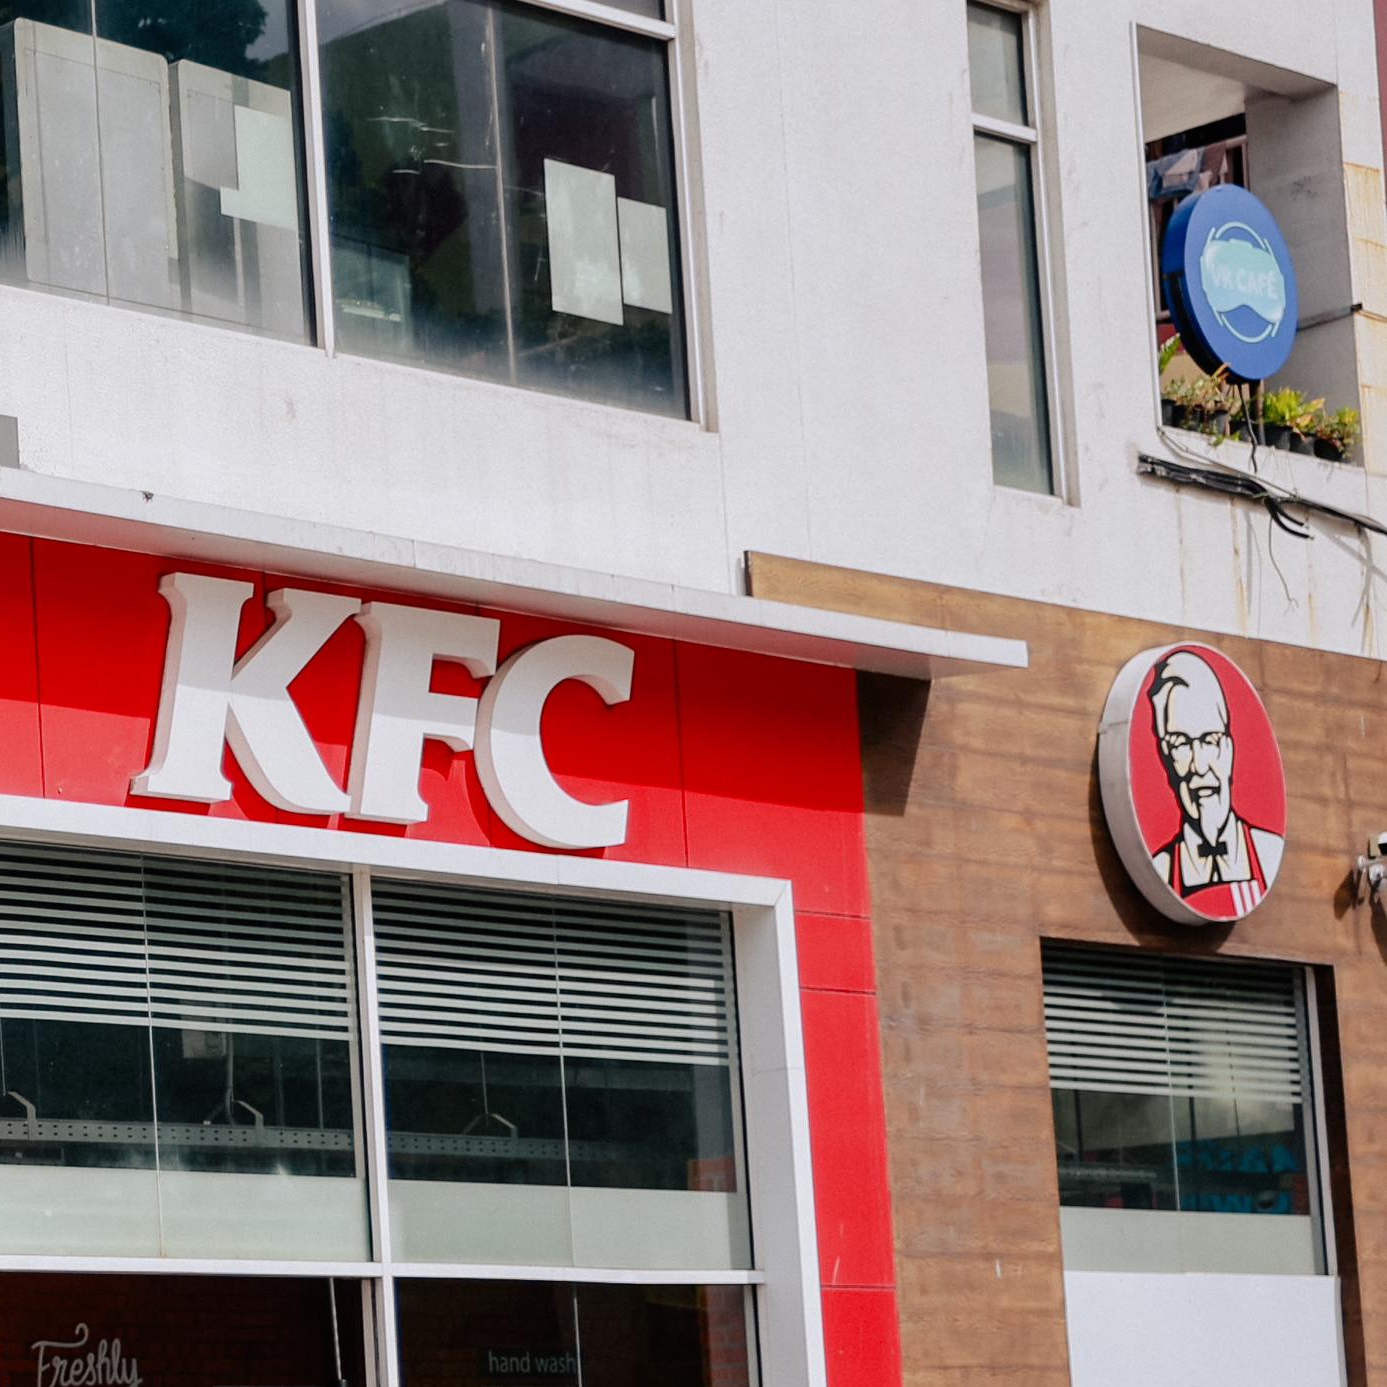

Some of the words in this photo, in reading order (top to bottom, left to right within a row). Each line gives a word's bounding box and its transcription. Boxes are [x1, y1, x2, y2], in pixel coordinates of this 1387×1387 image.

[130, 571, 635, 850] KFC
[489, 1350, 531, 1373] hand
[536, 1351, 577, 1375] wash
